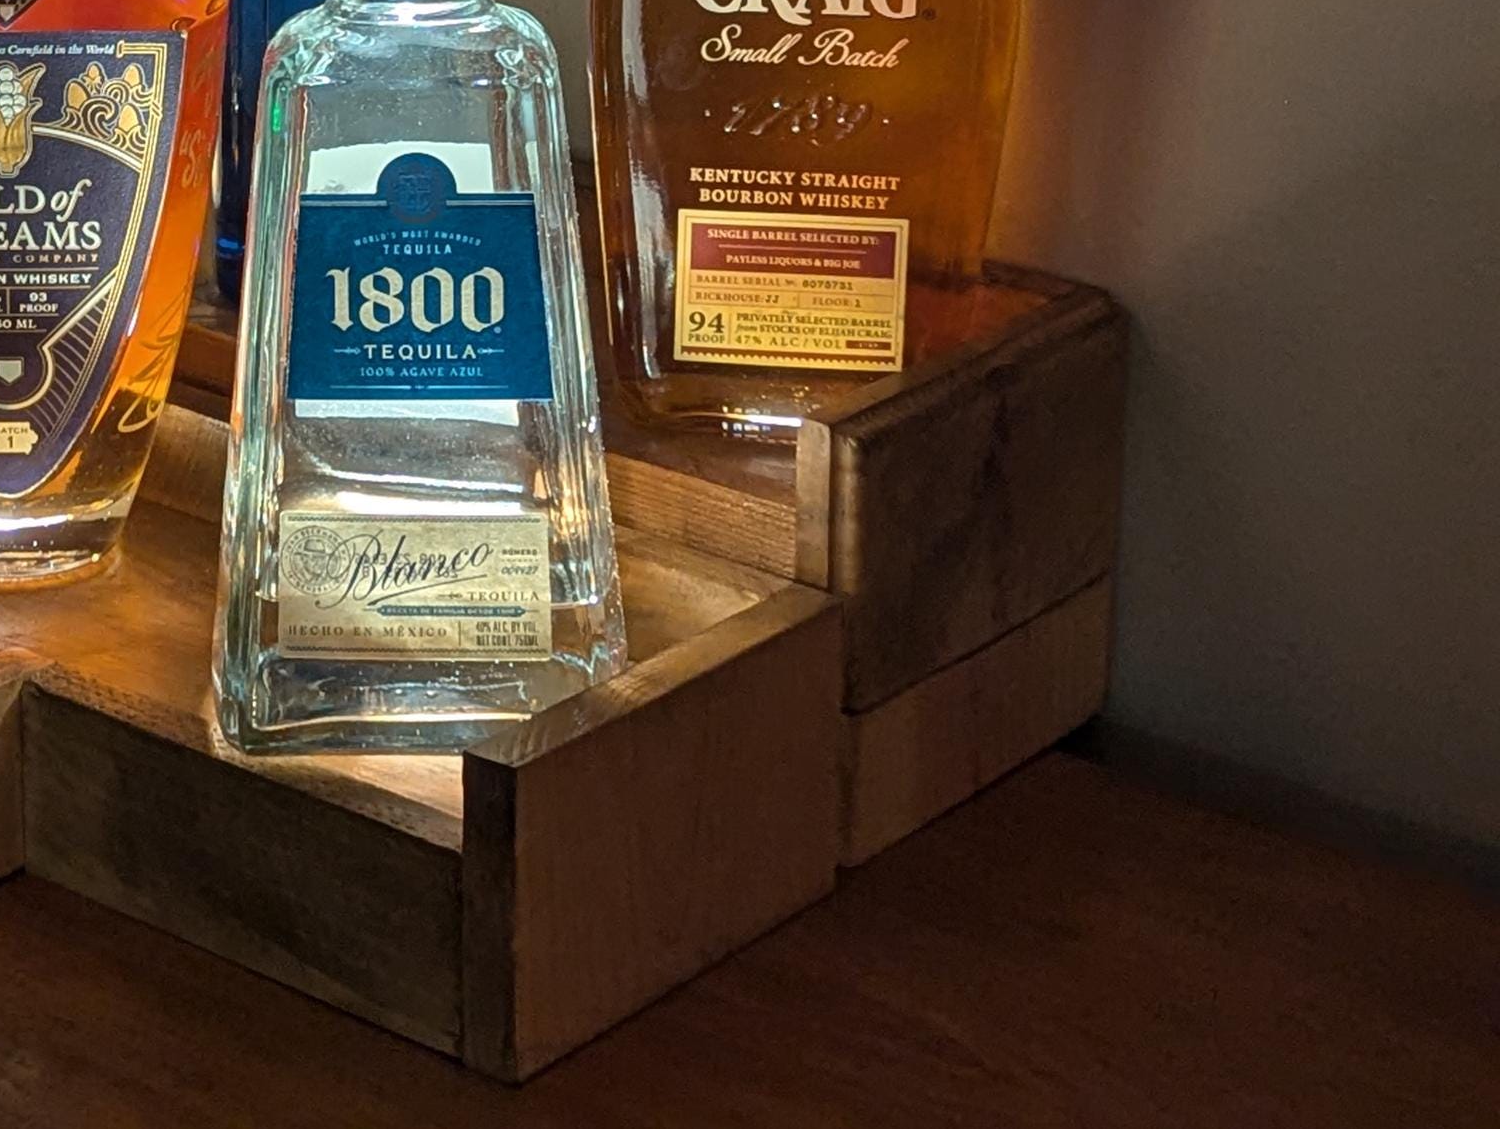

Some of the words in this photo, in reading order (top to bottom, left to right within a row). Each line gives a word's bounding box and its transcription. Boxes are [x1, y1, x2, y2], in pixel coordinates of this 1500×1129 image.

[8, 44, 52, 57] Cornfield
[55, 45, 66, 55] in
[68, 45, 83, 55] the
[85, 45, 115, 55] World
[701, 24, 801, 65] Small
[798, 28, 909, 69] Batch
[689, 167, 796, 187] KENTUCKY
[800, 172, 901, 191] STRAIGHT
[51, 178, 92, 222] of
[699, 189, 793, 205] BOURBON
[799, 193, 889, 210] WHISKEY
[707, 229, 749, 240] SINGLE
[752, 231, 798, 242] BARREL
[800, 233, 859, 245] SELECTED
[861, 236, 880, 246] BY:
[383, 244, 452, 256] TEQUILA
[13, 253, 98, 263] COMPANY
[726, 254, 767, 265] PAYLESS
[769, 256, 812, 268] LIQUORS
[813, 259, 822, 267] &
[843, 260, 861, 270] JOE
[14, 273, 92, 284] WHISKEY
[696, 274, 738, 285] BARREL
[742, 276, 781, 287] SERIAL
[29, 292, 47, 302] 93
[325, 266, 505, 333] 1800
[765, 294, 780, 304] JJ
[19, 304, 58, 313] PROOF
[16, 319, 37, 329] ML
[689, 311, 725, 333] 94
[736, 312, 794, 324] PRIVATELY
[795, 315, 849, 326] SELECTED
[851, 318, 891, 329] BARREL
[736, 324, 758, 335] from
[759, 325, 800, 335] STOCKS
[802, 327, 816, 336] OF
[818, 328, 856, 338] ELIJAH
[857, 330, 892, 339] CRAIG
[688, 333, 725, 344] PROOF
[736, 335, 762, 346] 47%
[770, 337, 799, 347] ALC
[813, 338, 842, 349] VOL
[363, 344, 477, 361] TEQUILA
[360, 366, 395, 377] 100%
[400, 366, 445, 377] AGAVE
[450, 366, 483, 377] AZUL
[7, 436, 15, 448] 1
[315, 529, 494, 610] Blanco
[468, 591, 540, 602] TEQUILA
[288, 625, 344, 637] HECHO
[353, 626, 372, 637] EN
[383, 624, 448, 638] MÉXICO
[476, 622, 491, 632] 40%
[511, 621, 521, 632] BY
[476, 635, 489, 646] NET
